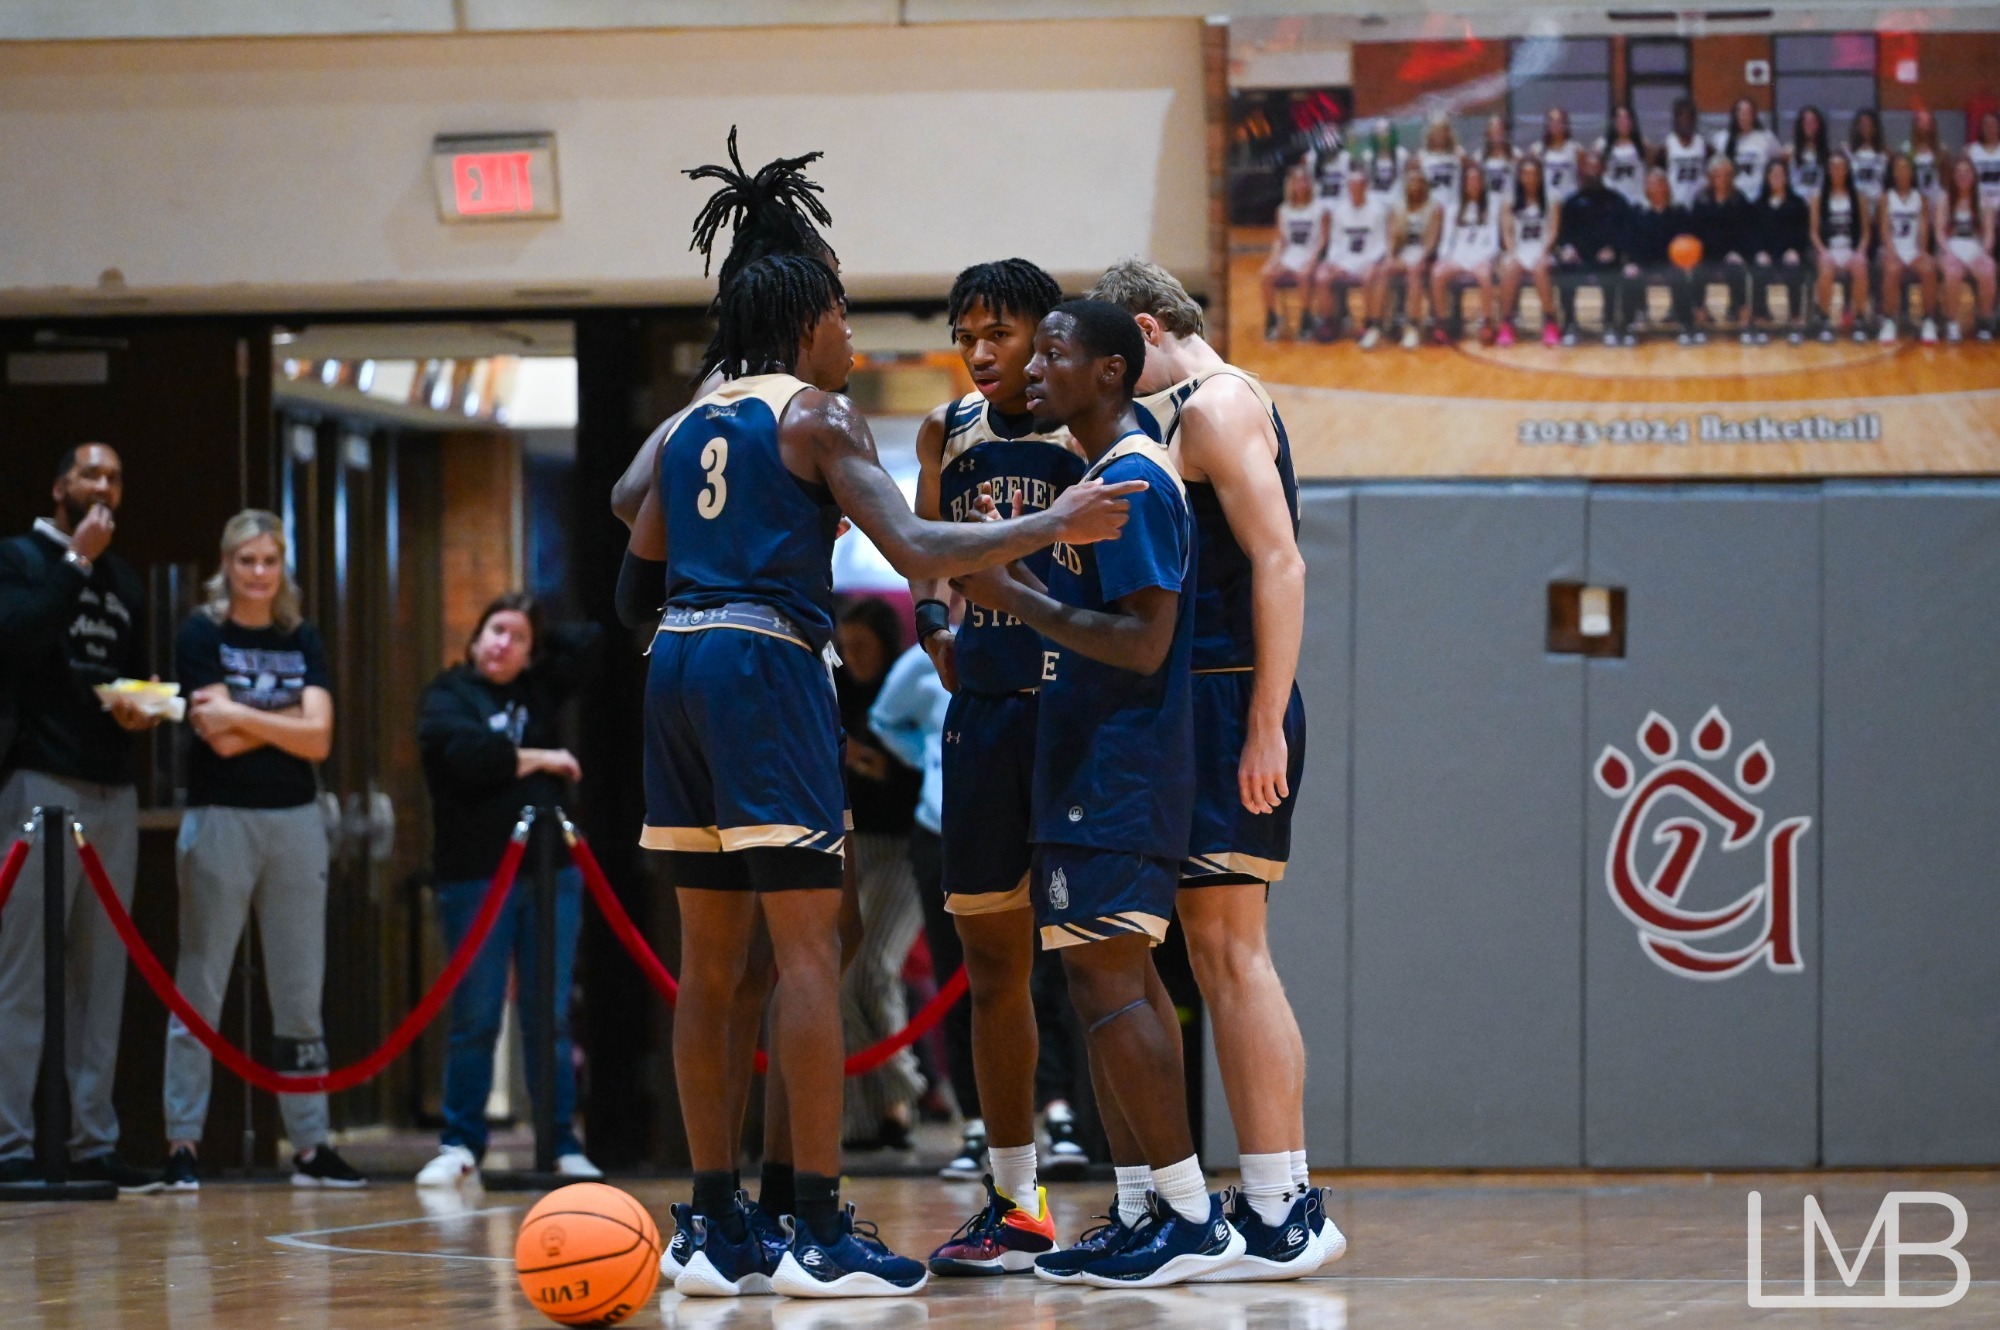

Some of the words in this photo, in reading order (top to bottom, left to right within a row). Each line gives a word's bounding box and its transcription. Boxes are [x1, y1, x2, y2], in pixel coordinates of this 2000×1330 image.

[453, 151, 533, 214] EXIT
[1698, 412, 1882, 443] Basketball
[697, 436, 728, 520] 3
